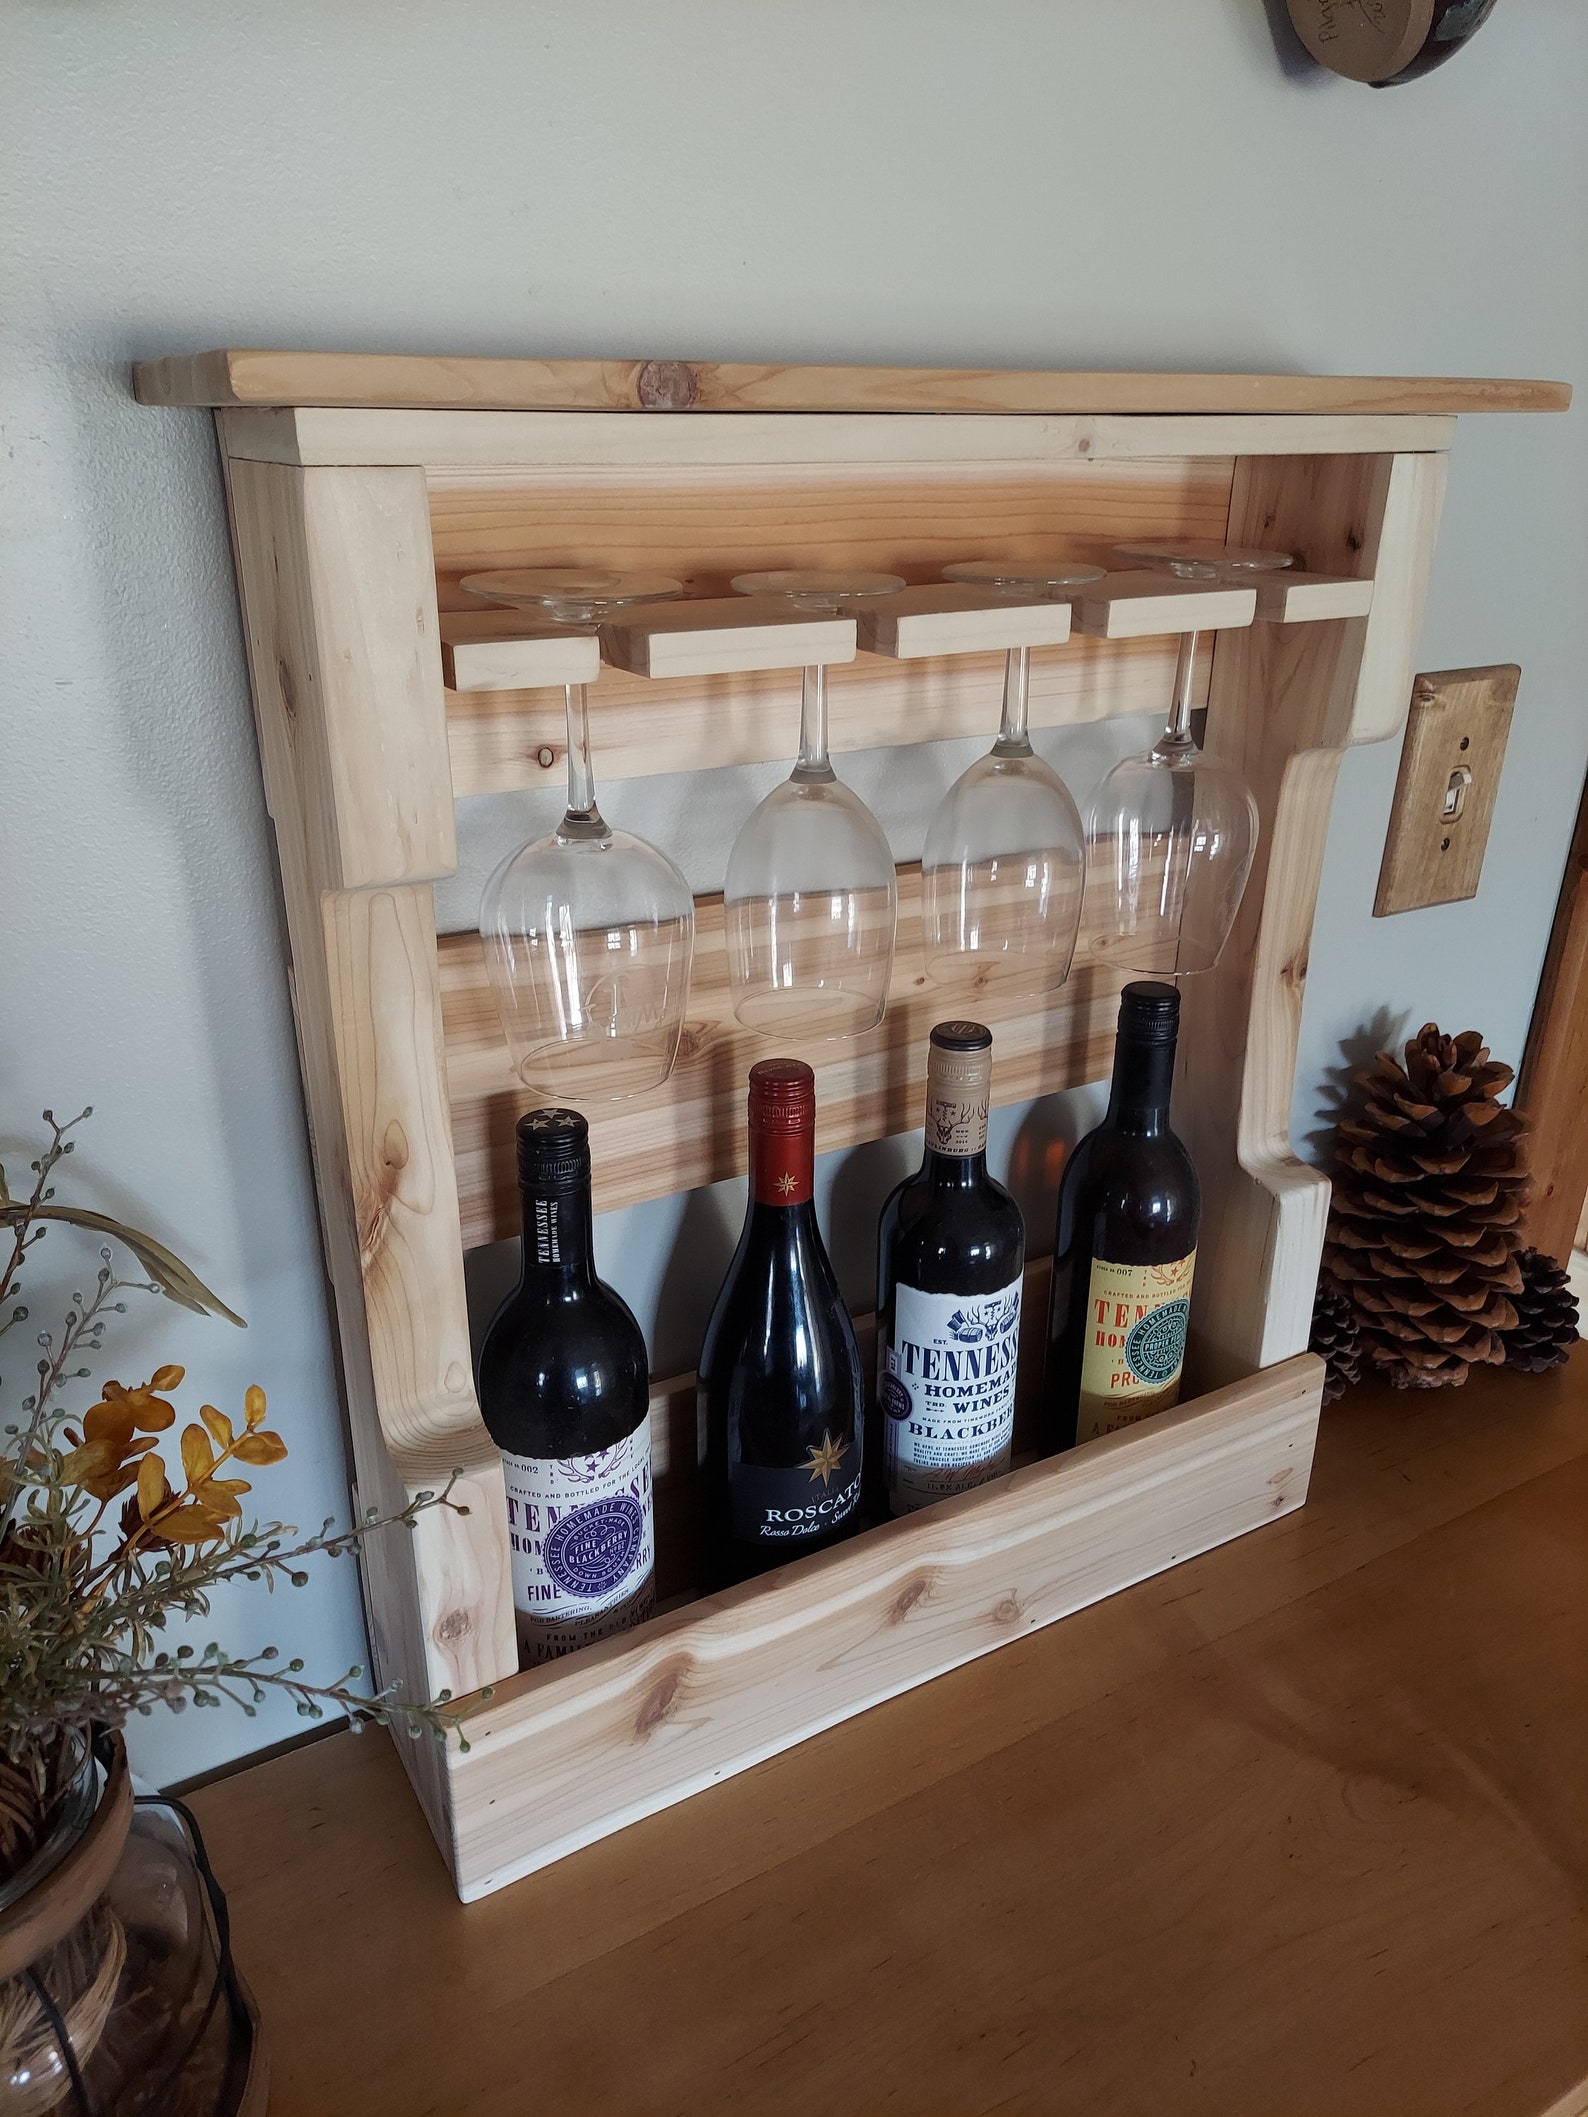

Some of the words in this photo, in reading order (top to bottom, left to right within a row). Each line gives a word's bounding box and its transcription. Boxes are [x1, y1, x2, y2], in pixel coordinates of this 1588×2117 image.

[550, 1201, 559, 1225] WINES
[536, 1200, 550, 1264] TENNESSEE
[551, 1226, 561, 1263] HOMEMADE
[1116, 1268, 1134, 1277] 007
[1103, 1289, 1134, 1299] CRAFTED
[1152, 1288, 1176, 1298] BOTTLED
[953, 1384, 1010, 1414] WINES
[521, 1464, 539, 1475] 002
[510, 1485, 542, 1499] CRAFTED
[564, 1486, 600, 1499] BOTTLED
[602, 1479, 617, 1489] FOR
[618, 1470, 631, 1482] THE
[765, 1472, 861, 1522] ROSCATO
[554, 1502, 616, 1542] HOMEMADE
[619, 1501, 639, 1525] WINES
[760, 1525, 790, 1537] Rosso
[791, 1520, 820, 1536] Dolce
[569, 1530, 628, 1564] BLACKBERRY
[575, 1540, 597, 1555] FINE
[550, 1545, 593, 1592] TENNESSEE
[572, 1566, 598, 1579] DOWN
[527, 1583, 562, 1601] FINE
[546, 1633, 576, 1642] FROM
[583, 1628, 604, 1640] THE
